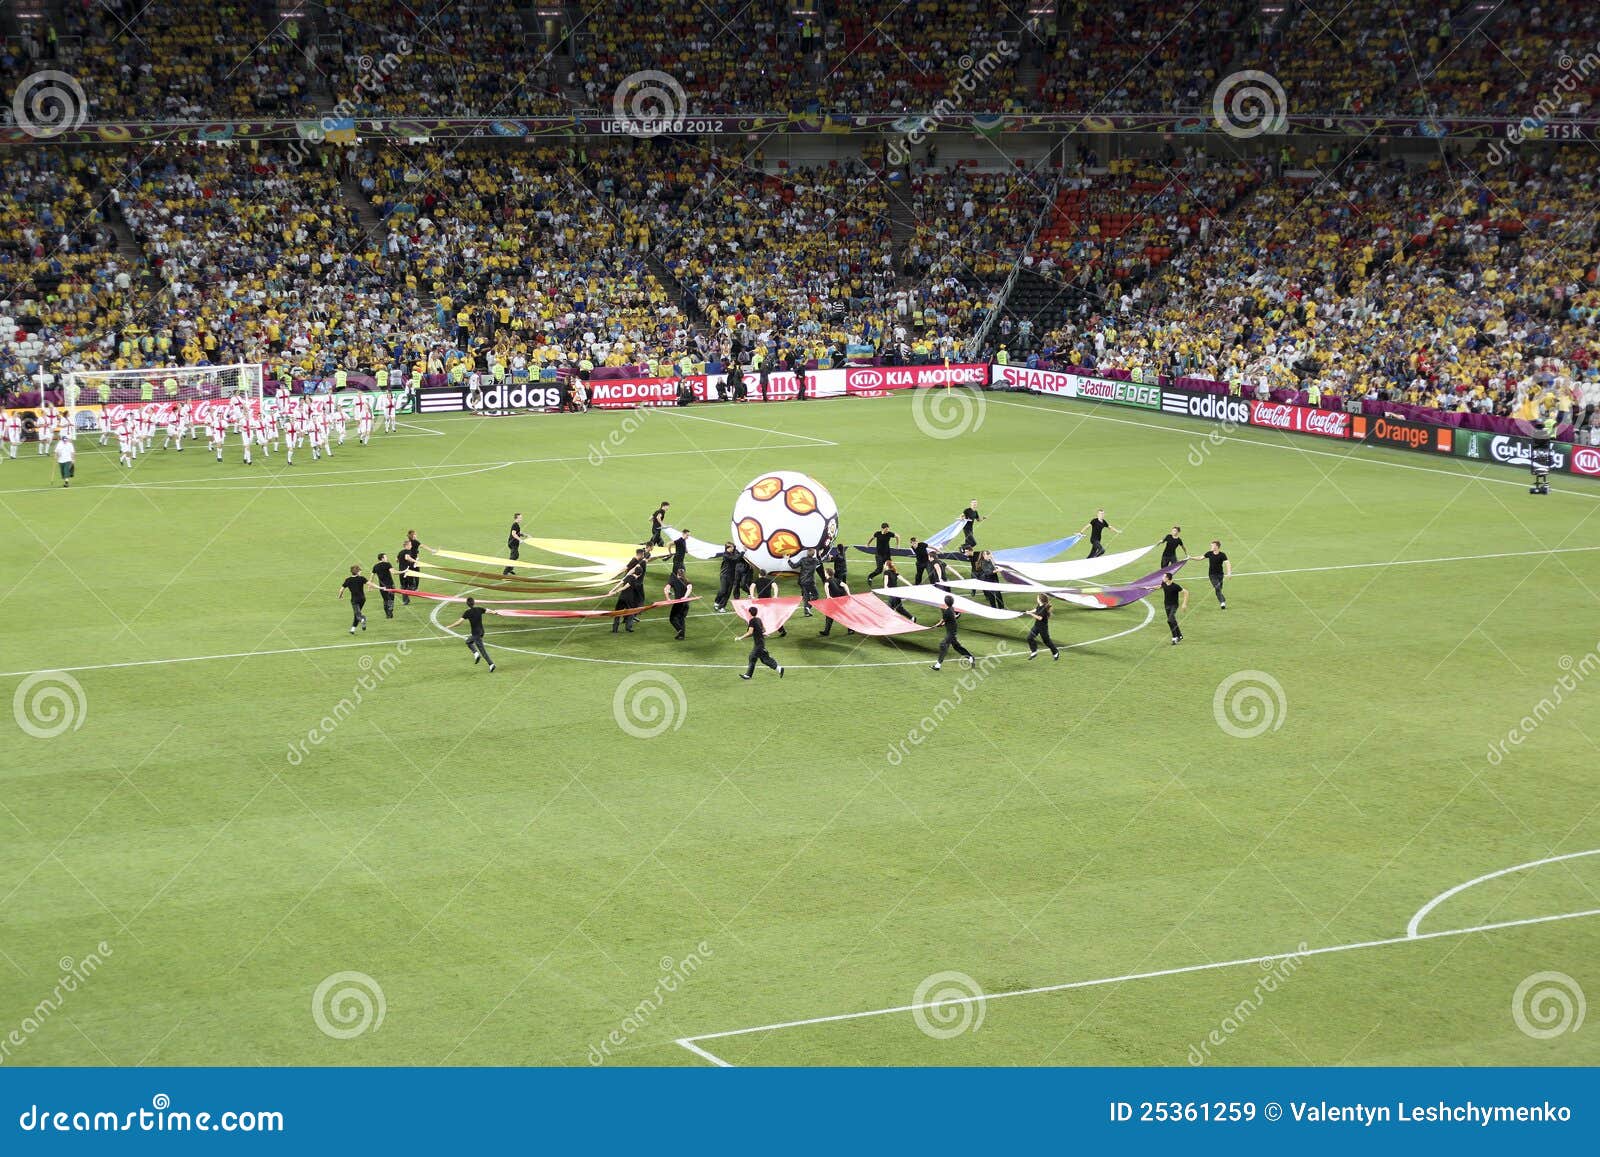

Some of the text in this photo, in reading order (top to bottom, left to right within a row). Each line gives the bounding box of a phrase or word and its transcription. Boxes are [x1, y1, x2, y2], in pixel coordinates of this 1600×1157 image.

[601, 121, 723, 133] UEFA EURO 2012
[886, 371, 914, 385] KIA
[917, 367, 984, 383] MOTORS
[1003, 368, 1067, 391] SHARP
[465, 384, 560, 409] adidas
[593, 381, 704, 399] McDonal's
[1084, 379, 1160, 405] Castrol EDGE
[1189, 394, 1249, 422] adidas
[1375, 418, 1428, 448] Orange
